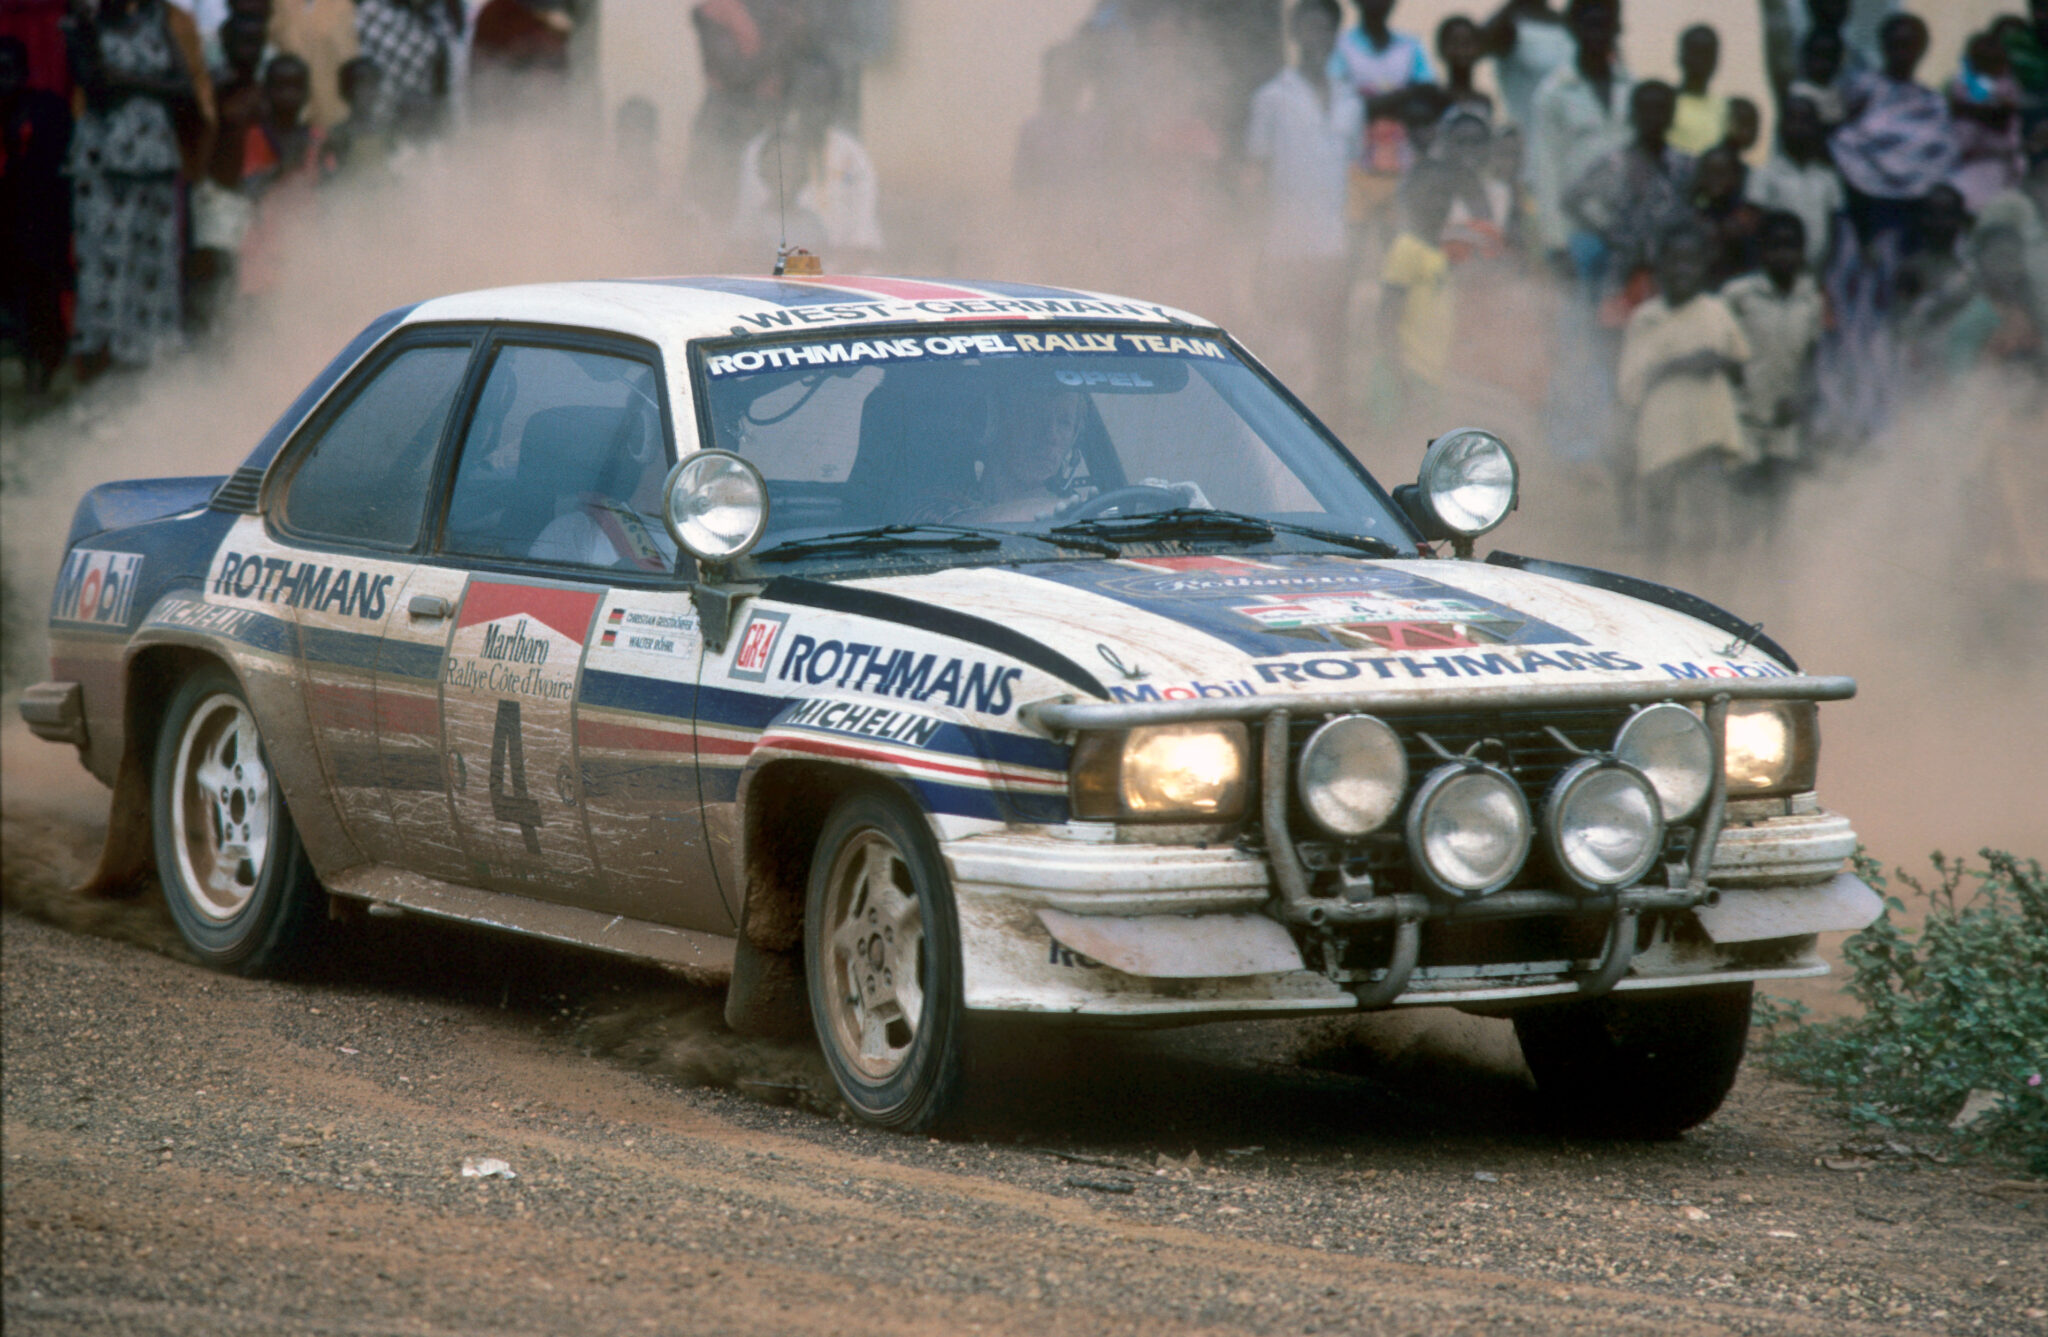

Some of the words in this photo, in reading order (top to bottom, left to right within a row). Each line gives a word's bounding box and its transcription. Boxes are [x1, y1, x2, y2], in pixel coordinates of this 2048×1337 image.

[706, 337, 923, 375] ROTHMANS
[924, 334, 1018, 356] OPEL
[1013, 333, 1119, 352] RALLY
[1121, 334, 1226, 360] TEAM
[1054, 370, 1154, 388] OPEL
[58, 551, 139, 624] Mobil
[213, 551, 395, 621] ROTHMANS
[480, 620, 550, 665] Marlboro
[736, 620, 780, 670] GR4
[444, 657, 489, 695] Rallye
[488, 662, 520, 692] Côte
[520, 666, 574, 701] d'Ivoire
[778, 633, 1023, 716] ROTHMANS
[1253, 650, 1644, 684] ROTHMANS
[1659, 660, 1790, 680] Mobil
[1108, 680, 1257, 703] Mobil
[785, 699, 943, 747] MICHELIN
[489, 698, 544, 854] 4
